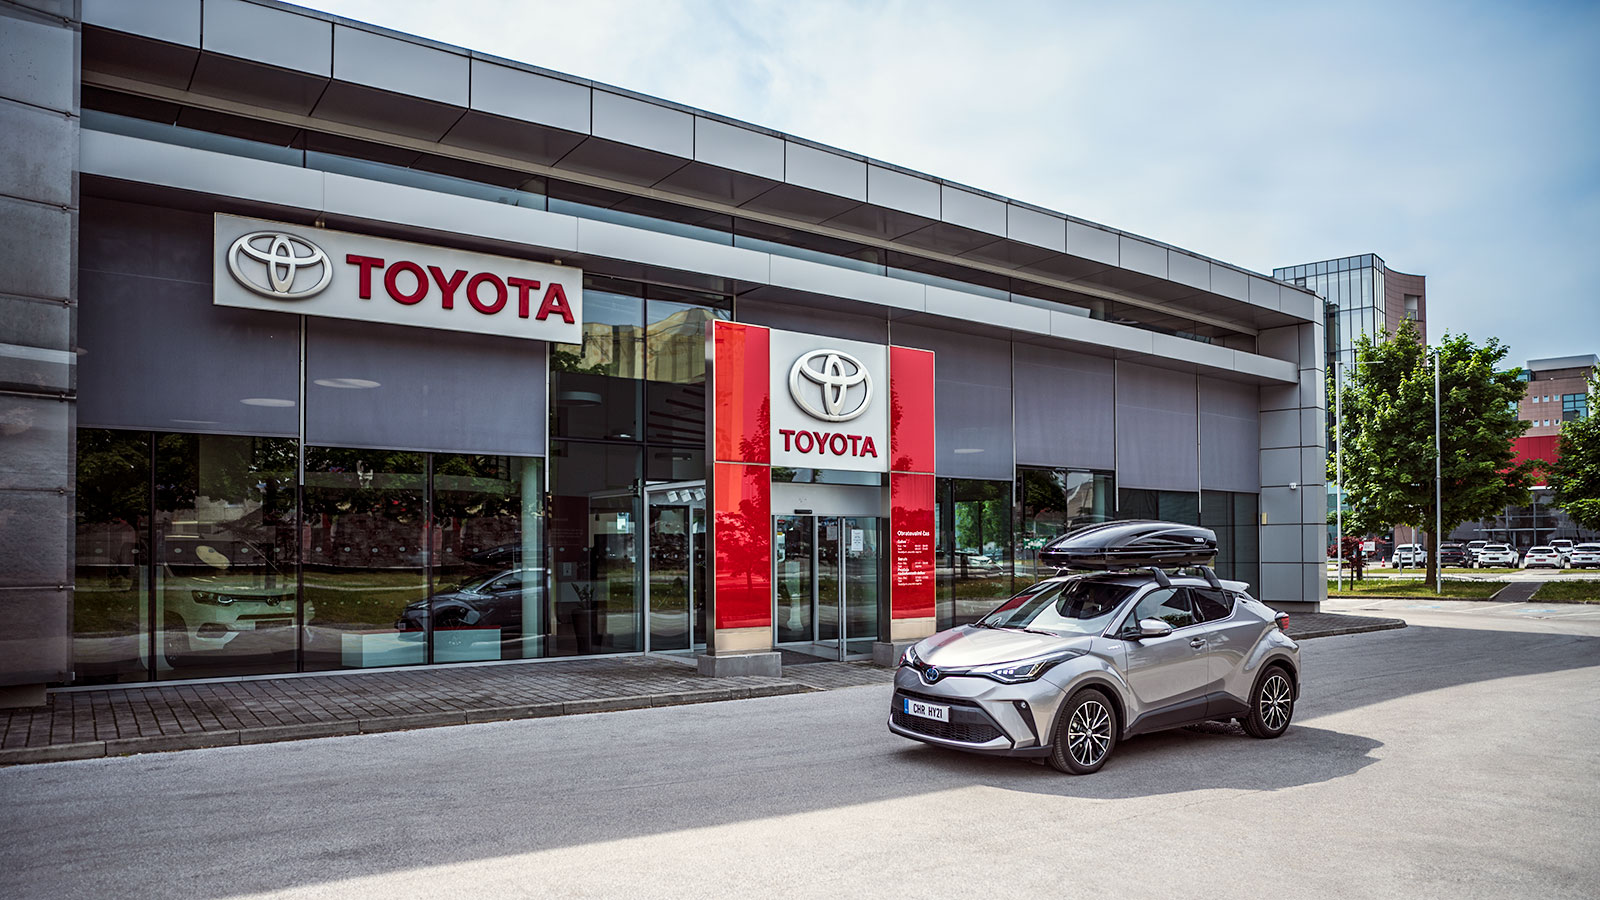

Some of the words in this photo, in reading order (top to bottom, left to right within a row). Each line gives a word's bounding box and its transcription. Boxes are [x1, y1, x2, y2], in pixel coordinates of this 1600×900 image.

[346, 254, 575, 324] TOYOTA
[779, 429, 878, 458] TOYOTA
[913, 703, 926, 715] CHR
[928, 706, 943, 719] HY21
